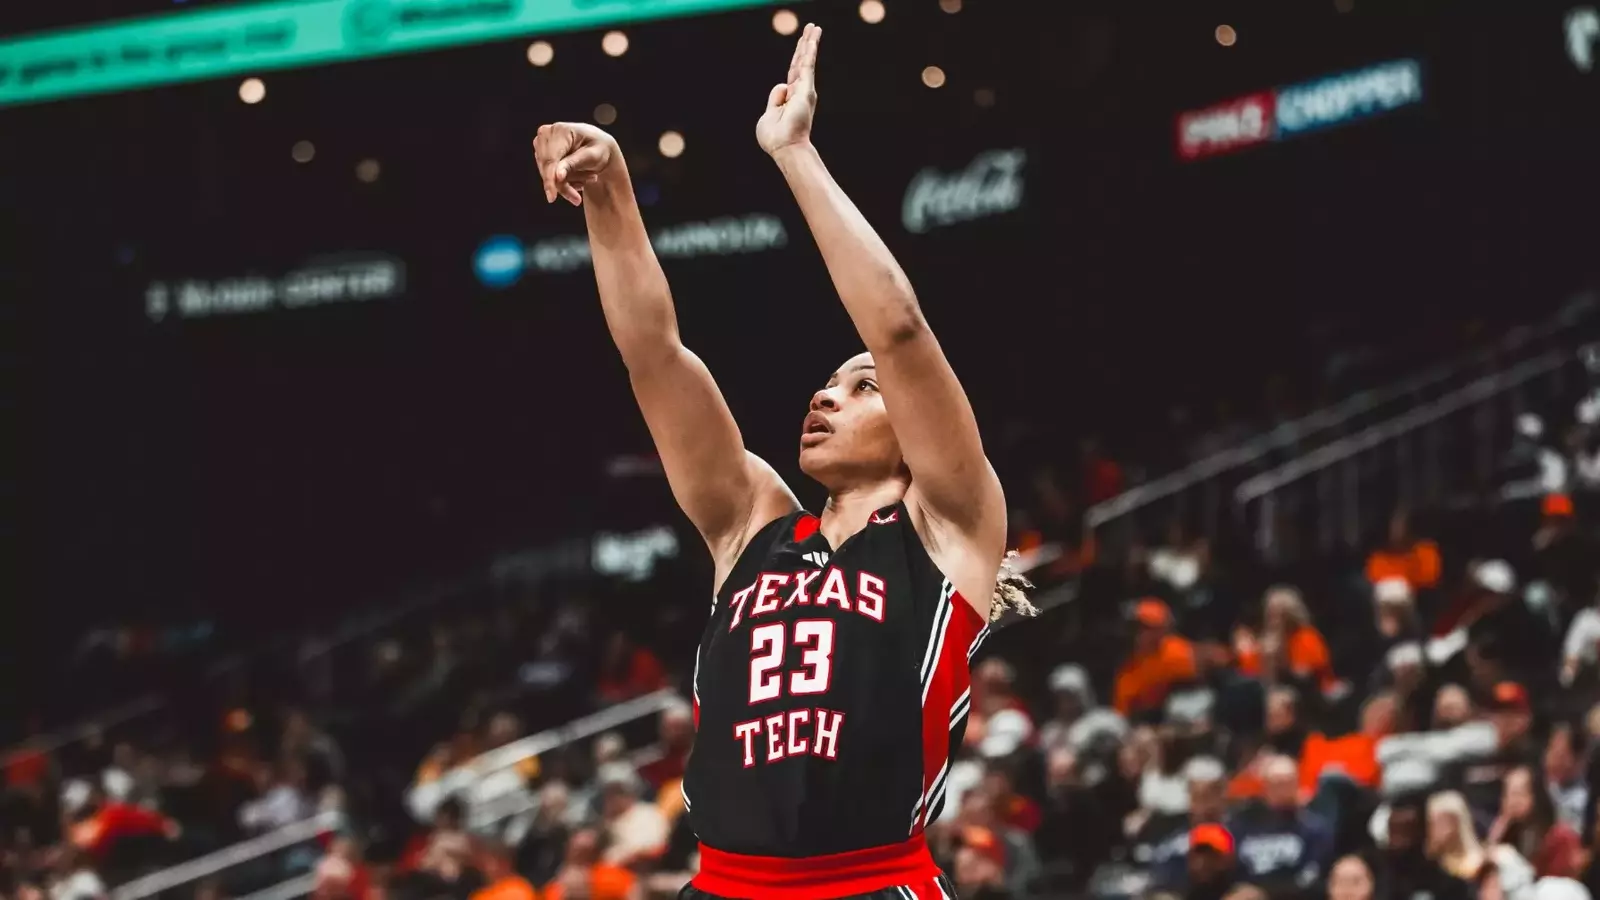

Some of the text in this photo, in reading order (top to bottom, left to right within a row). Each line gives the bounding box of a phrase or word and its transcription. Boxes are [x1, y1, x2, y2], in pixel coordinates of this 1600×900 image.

[729, 565, 886, 632] TEXAS
[748, 618, 835, 705] 23
[733, 708, 844, 768] TECH
